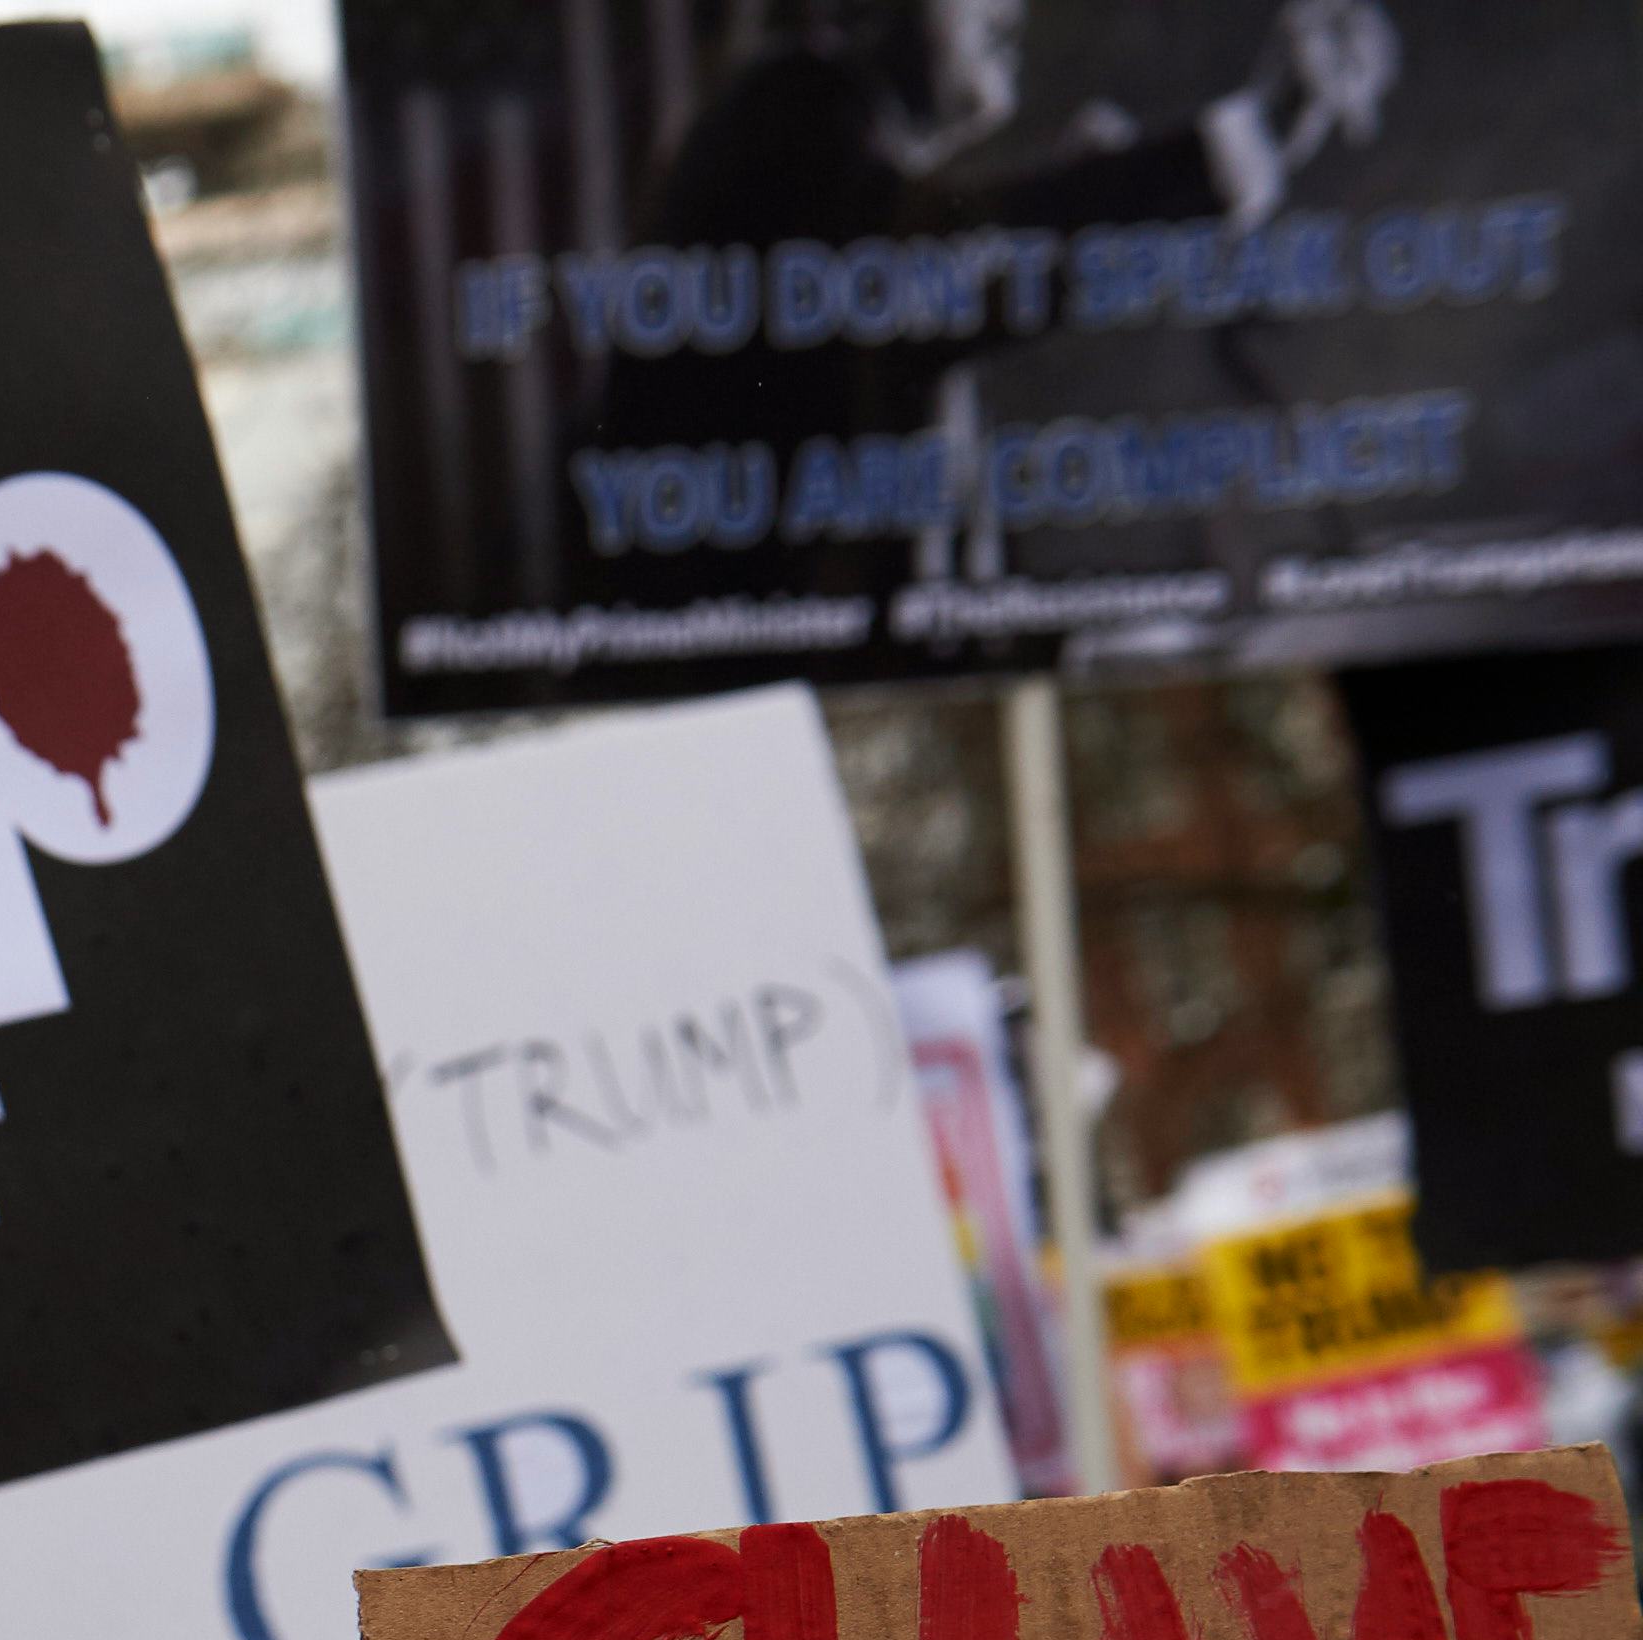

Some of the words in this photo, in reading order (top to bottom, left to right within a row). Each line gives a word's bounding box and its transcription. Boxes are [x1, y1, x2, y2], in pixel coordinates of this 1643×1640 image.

[560, 244, 761, 358] YOU
[771, 228, 1054, 348] DON'T
[1072, 211, 1353, 324] SPEAK
[1365, 197, 1565, 304] OUT
[574, 439, 775, 555] YOU
[787, 426, 956, 543] ARE
[987, 394, 1467, 518] COMPLICIT
